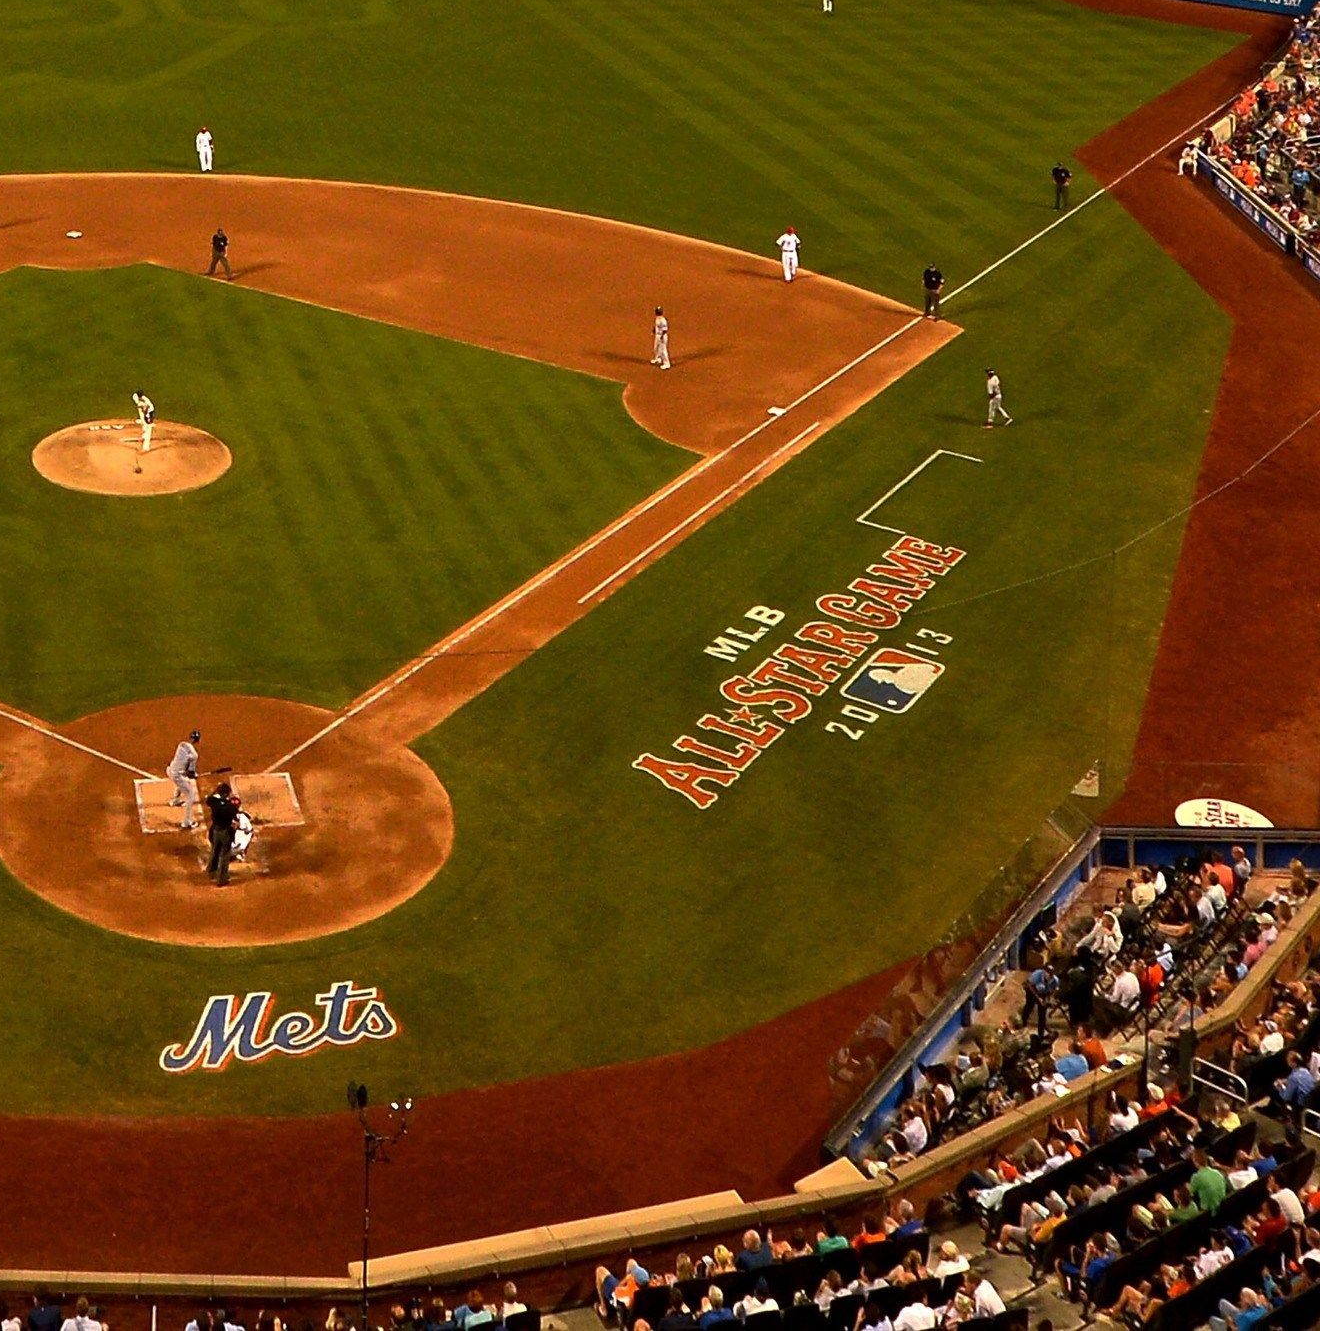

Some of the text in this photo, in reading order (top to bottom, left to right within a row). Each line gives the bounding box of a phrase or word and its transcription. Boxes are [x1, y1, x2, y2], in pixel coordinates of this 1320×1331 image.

[816, 535, 967, 629] GAME
[703, 605, 786, 662] MLB
[159, 980, 401, 1073] Mets
